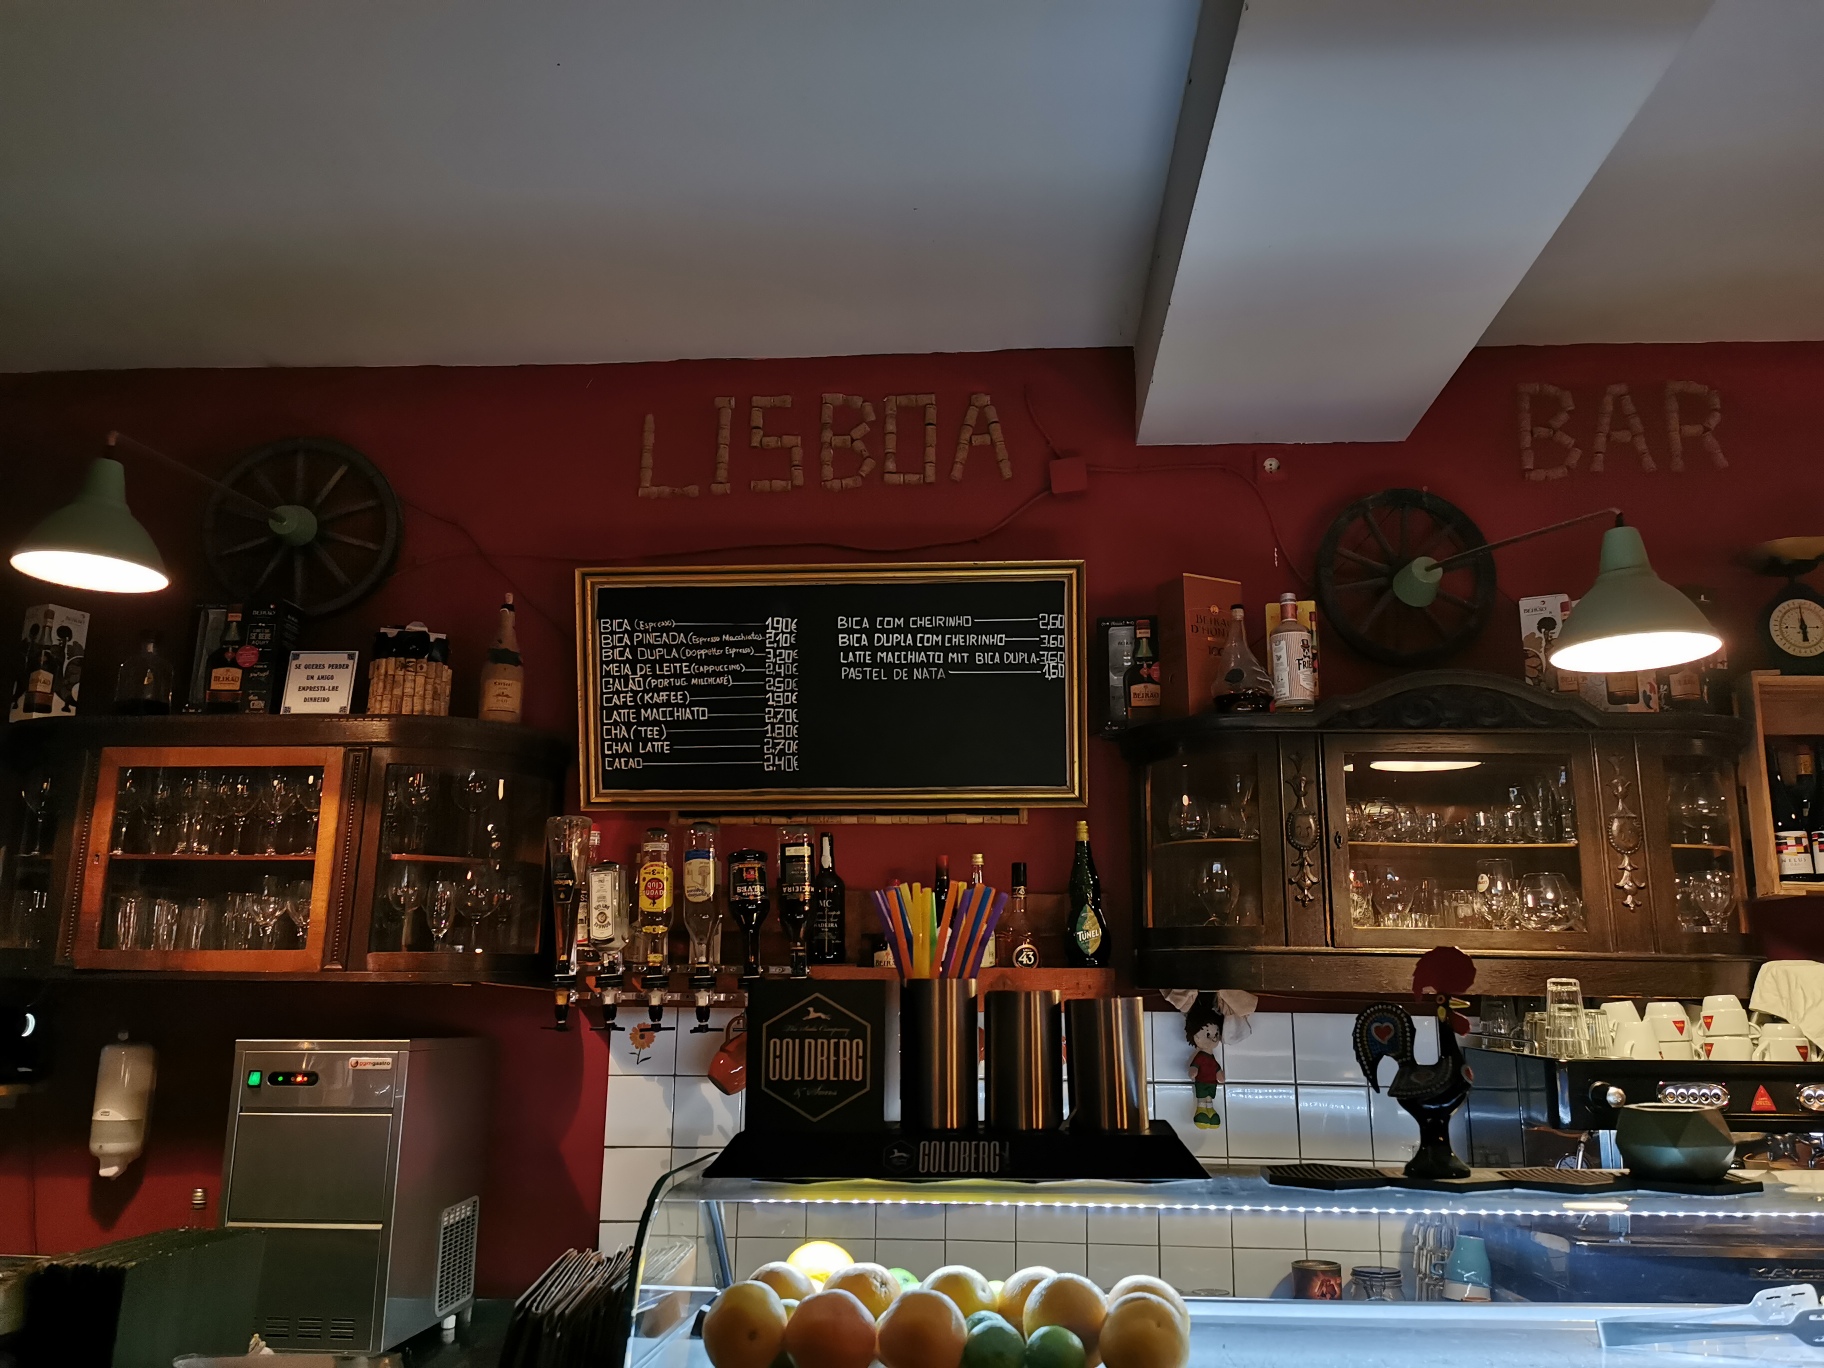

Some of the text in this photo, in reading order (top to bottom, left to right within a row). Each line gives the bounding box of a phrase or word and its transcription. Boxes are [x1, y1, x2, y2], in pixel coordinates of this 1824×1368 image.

[1517, 380, 1730, 481] BAR
[638, 393, 1013, 497] LISBOA
[601, 619, 631, 632] BICA
[837, 616, 870, 629] BICA
[876, 617, 904, 628] COM
[909, 615, 972, 628] CHEIRINHO
[601, 633, 631, 647] BICA
[634, 632, 687, 645] PINGADA
[838, 633, 868, 647] BICA
[874, 633, 914, 646] DUPLA
[916, 634, 942, 646] COM
[944, 633, 1005, 646] CHEIRINHO
[602, 648, 632, 660] BICA
[637, 648, 679, 660] DUPLA
[840, 651, 872, 663] LATTE
[877, 651, 944, 664] MACCHIATO
[949, 652, 970, 664] MIT
[975, 652, 1000, 664] BICA
[1003, 652, 1038, 664] DUPLA
[603, 664, 631, 676] MEIA
[636, 664, 652, 676] DE
[656, 663, 691, 675] LEITE
[841, 667, 888, 680] PASTEL
[893, 668, 909, 680] DE
[913, 667, 946, 680] NATA
[637, 691, 690, 705] (KAFFEE)
[603, 709, 637, 723] LATTE
[641, 707, 708, 721] MACCHIATO
[630, 724, 667, 740] (TEE)
[604, 742, 632, 754] CHAI
[639, 742, 671, 754] LATTE
[605, 758, 643, 770] CACAO
[736, 885, 765, 893] SILVES
[819, 900, 832, 908] MC
[1017, 951, 1035, 964] 43
[769, 1038, 863, 1081] GOLDBERG
[918, 1139, 1001, 1173] GOLDBERG
